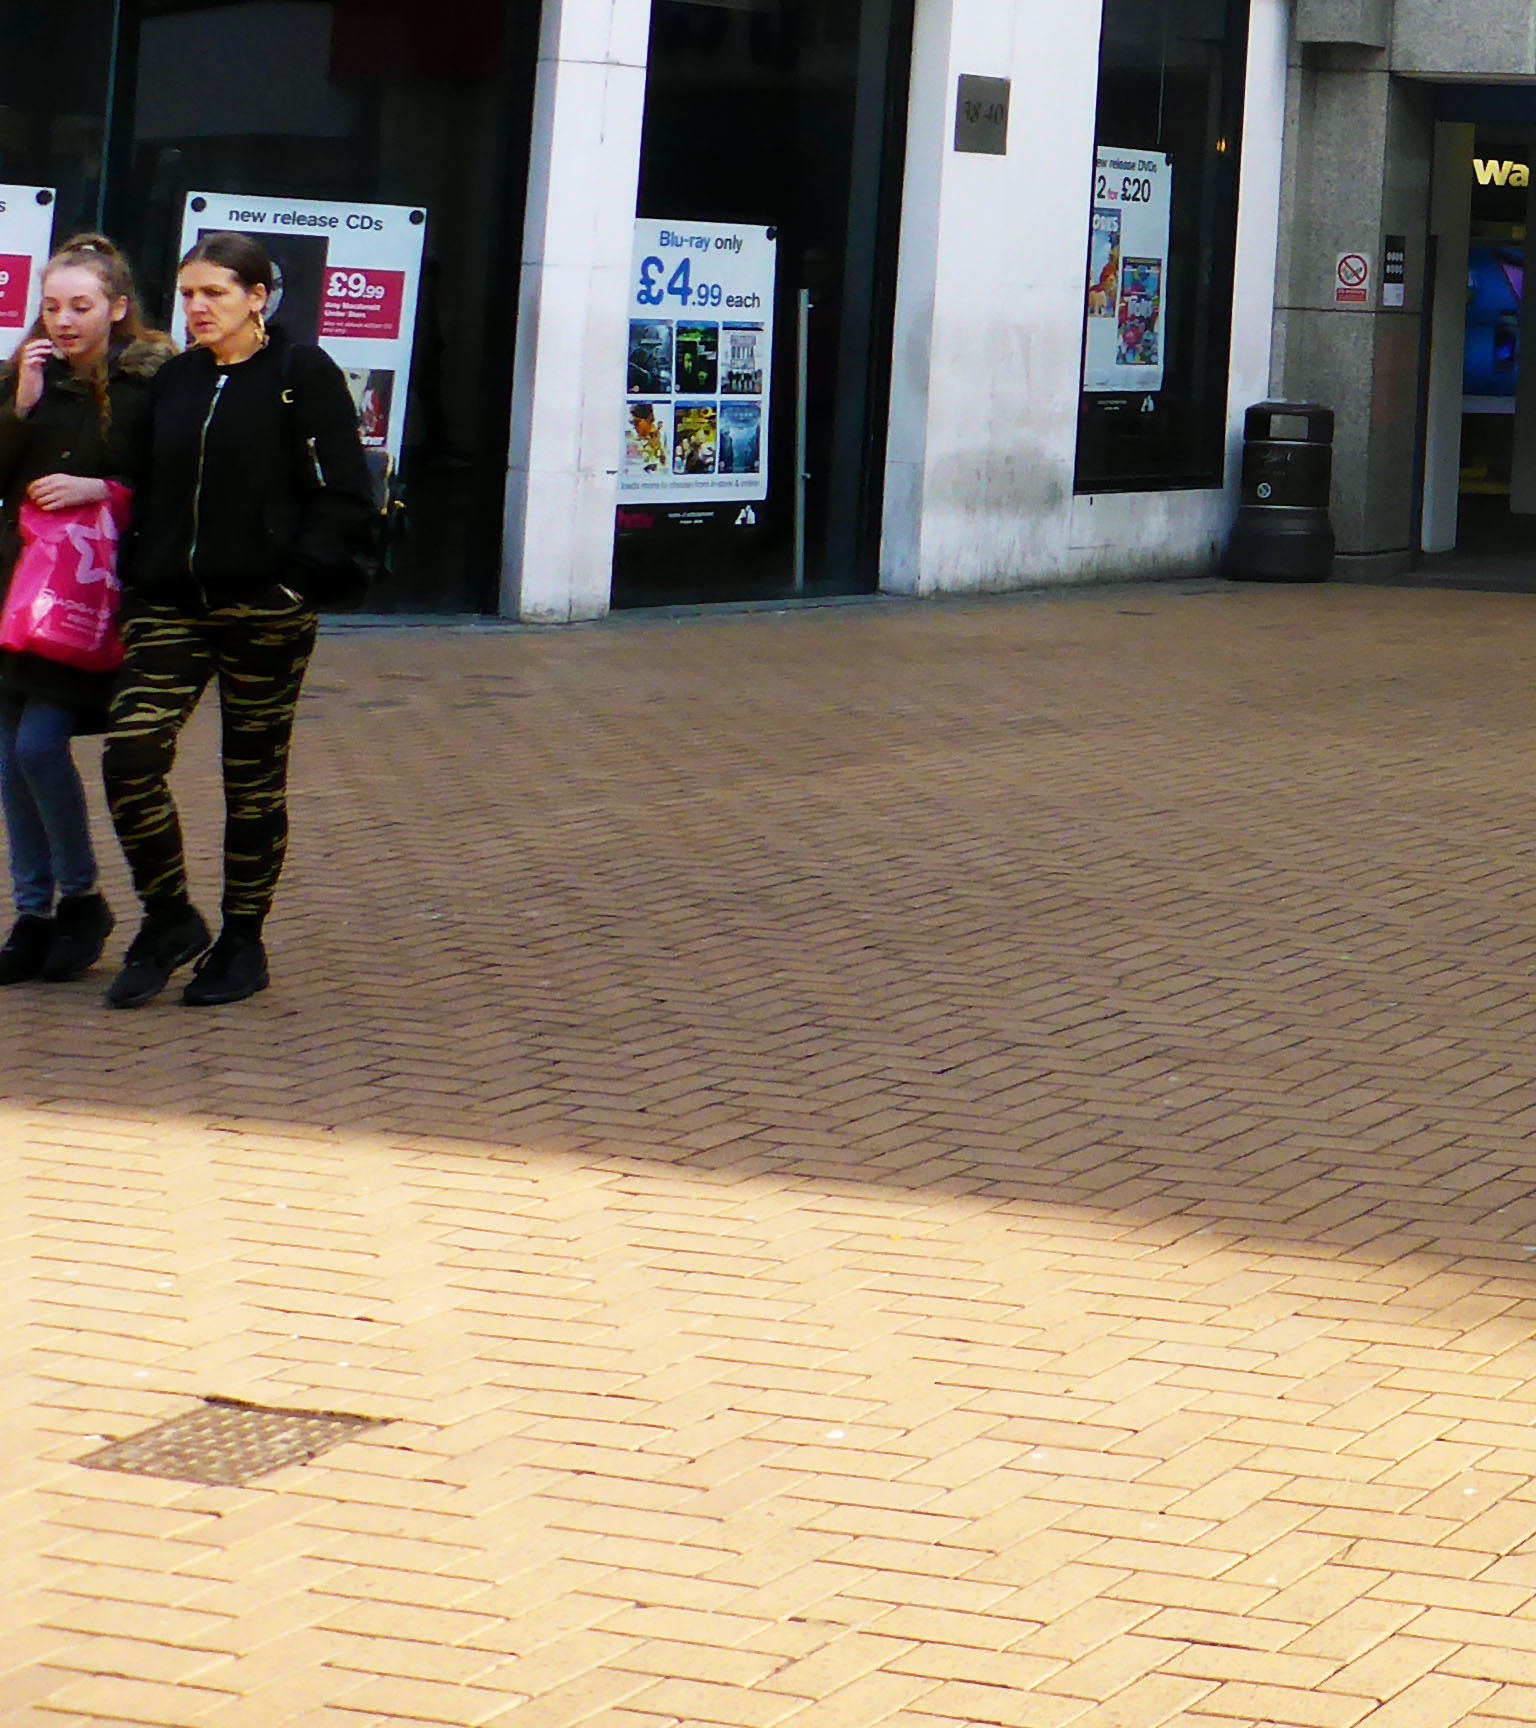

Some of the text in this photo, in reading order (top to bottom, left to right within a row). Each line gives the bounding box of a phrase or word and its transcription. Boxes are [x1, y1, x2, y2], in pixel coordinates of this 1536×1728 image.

[1096, 158, 1107, 168] ew
[1097, 174, 1107, 199] 2
[1121, 176, 1151, 203] £20
[228, 208, 384, 231] new release CDs
[659, 230, 743, 254] Blu-ray only
[327, 271, 385, 300] £9.99
[636, 256, 761, 308] £4.99 each
